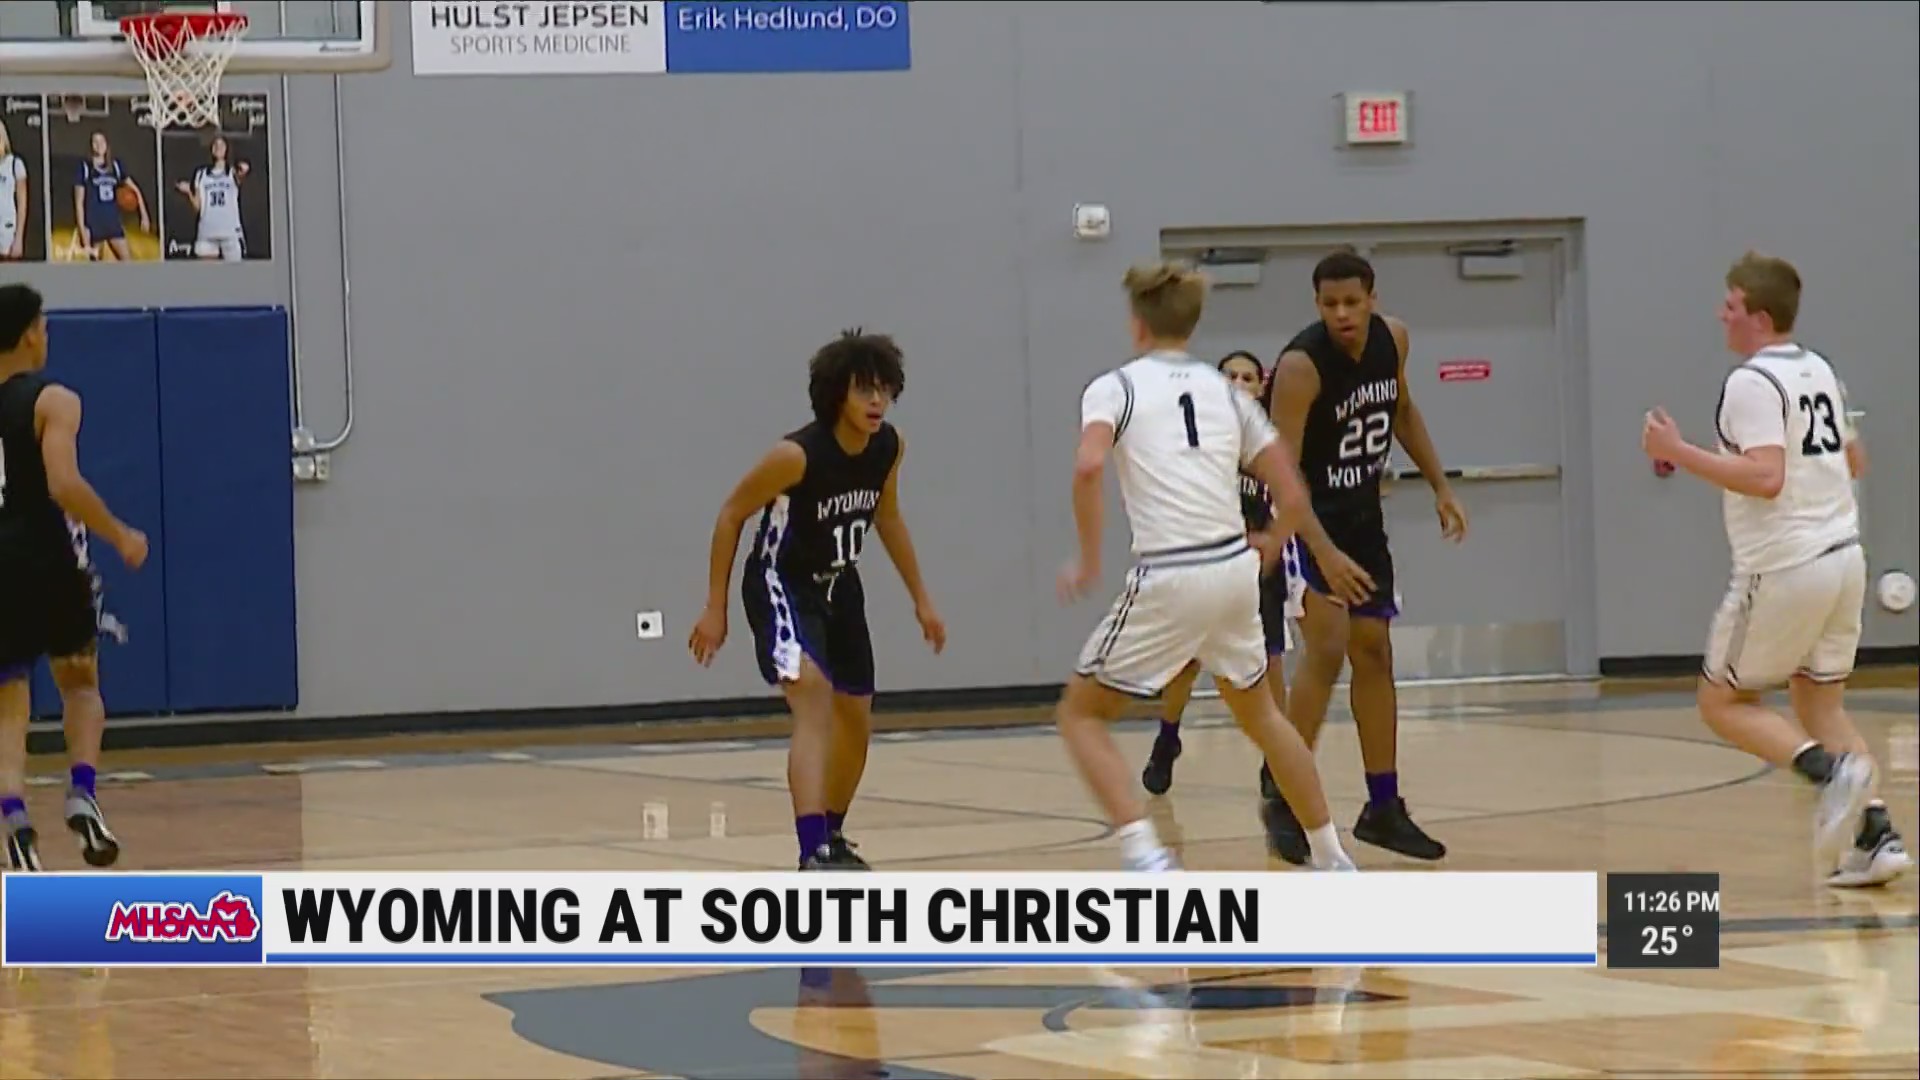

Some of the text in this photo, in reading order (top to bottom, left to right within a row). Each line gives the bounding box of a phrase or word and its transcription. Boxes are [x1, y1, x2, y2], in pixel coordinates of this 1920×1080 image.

[431, 4, 648, 28] HULST JEPSEN
[678, 6, 896, 31] Erik Hedlund, DO
[450, 35, 631, 54] SPORTS MEDICINE
[1359, 101, 1399, 133] EXIT
[1178, 391, 1199, 448] 1
[1339, 410, 1390, 460] 22
[1799, 392, 1841, 456] 23
[817, 488, 881, 521] WYOMIN
[831, 519, 867, 567] 10
